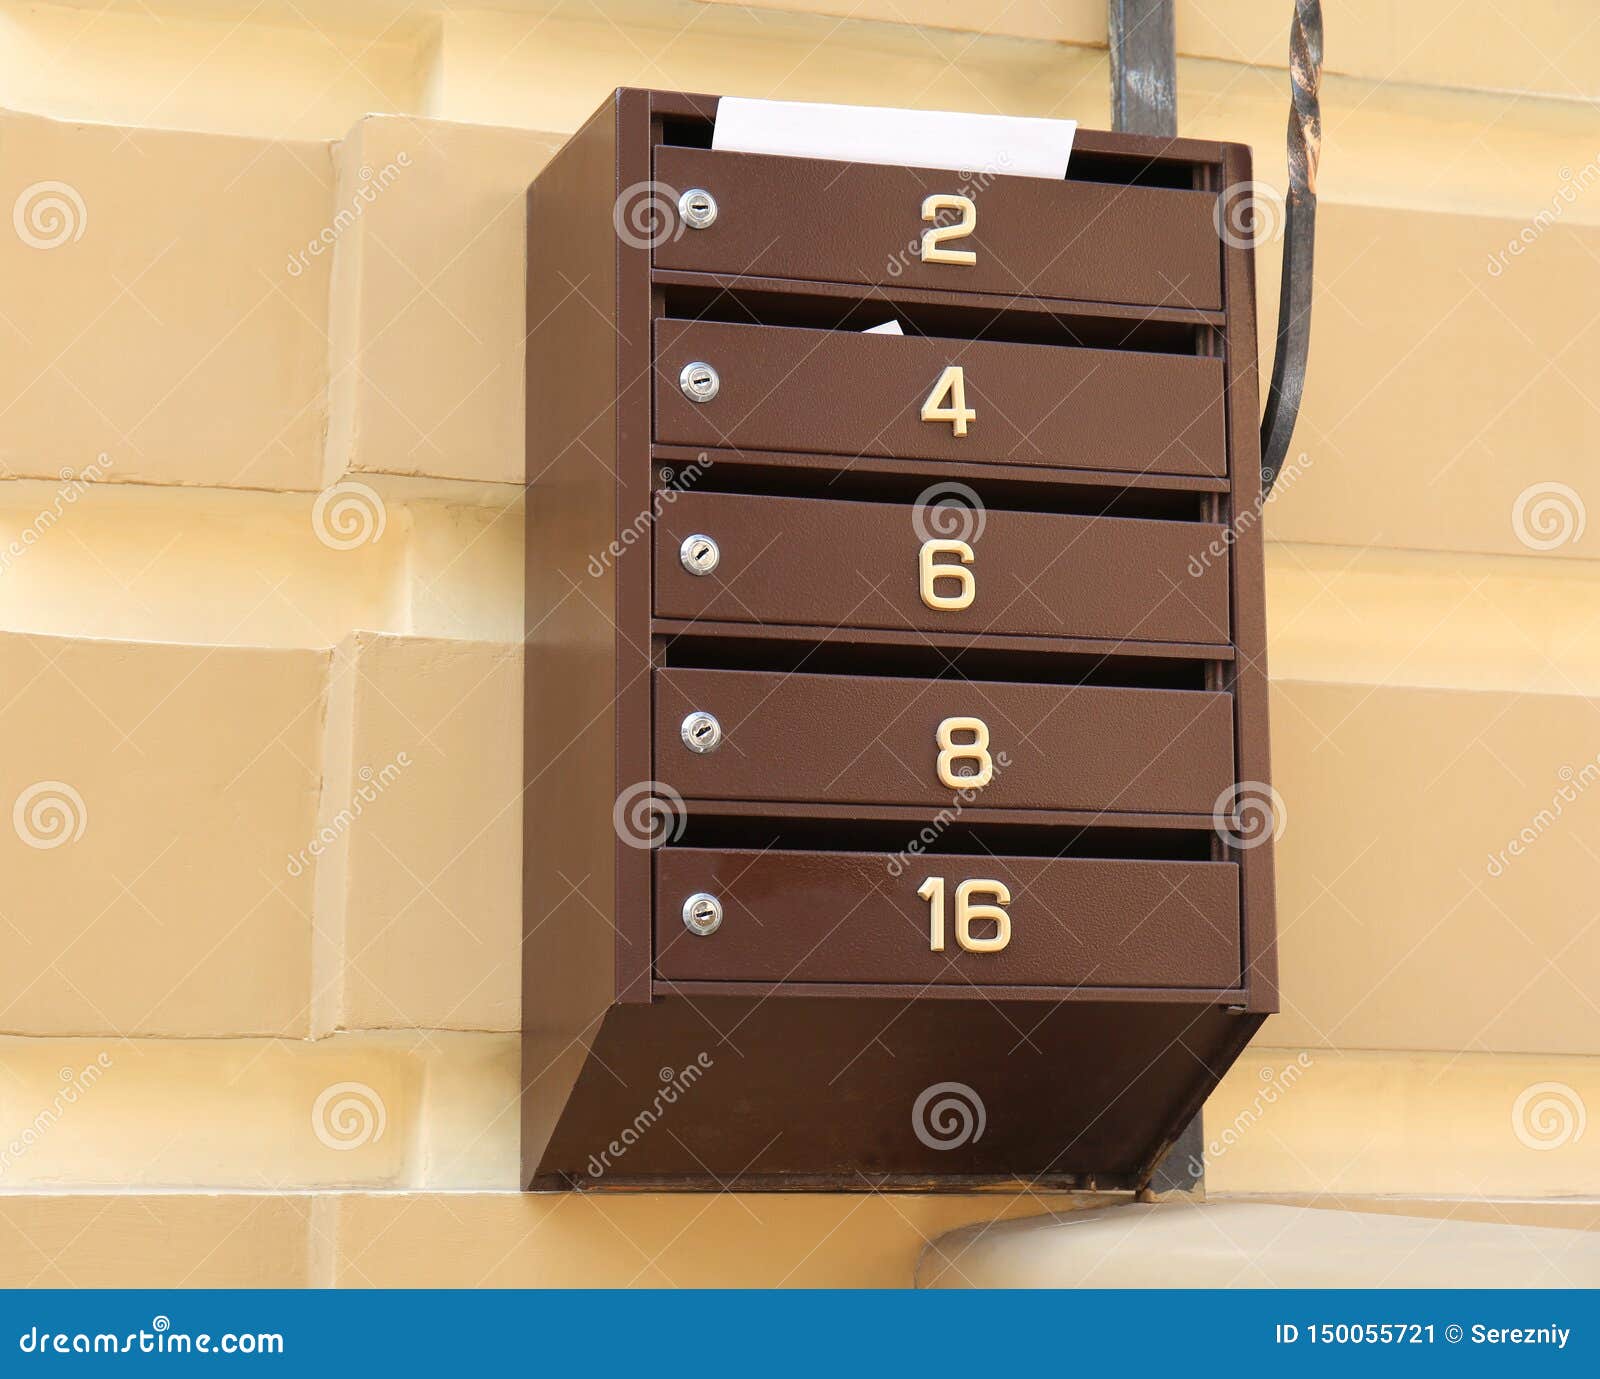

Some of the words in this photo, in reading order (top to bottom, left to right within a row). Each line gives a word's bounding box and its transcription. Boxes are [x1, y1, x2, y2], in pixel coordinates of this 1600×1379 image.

[921, 194, 977, 266] 2
[921, 366, 976, 437] 4
[919, 539, 976, 611] 6
[936, 717, 992, 789] 8
[917, 876, 1011, 953] 16
